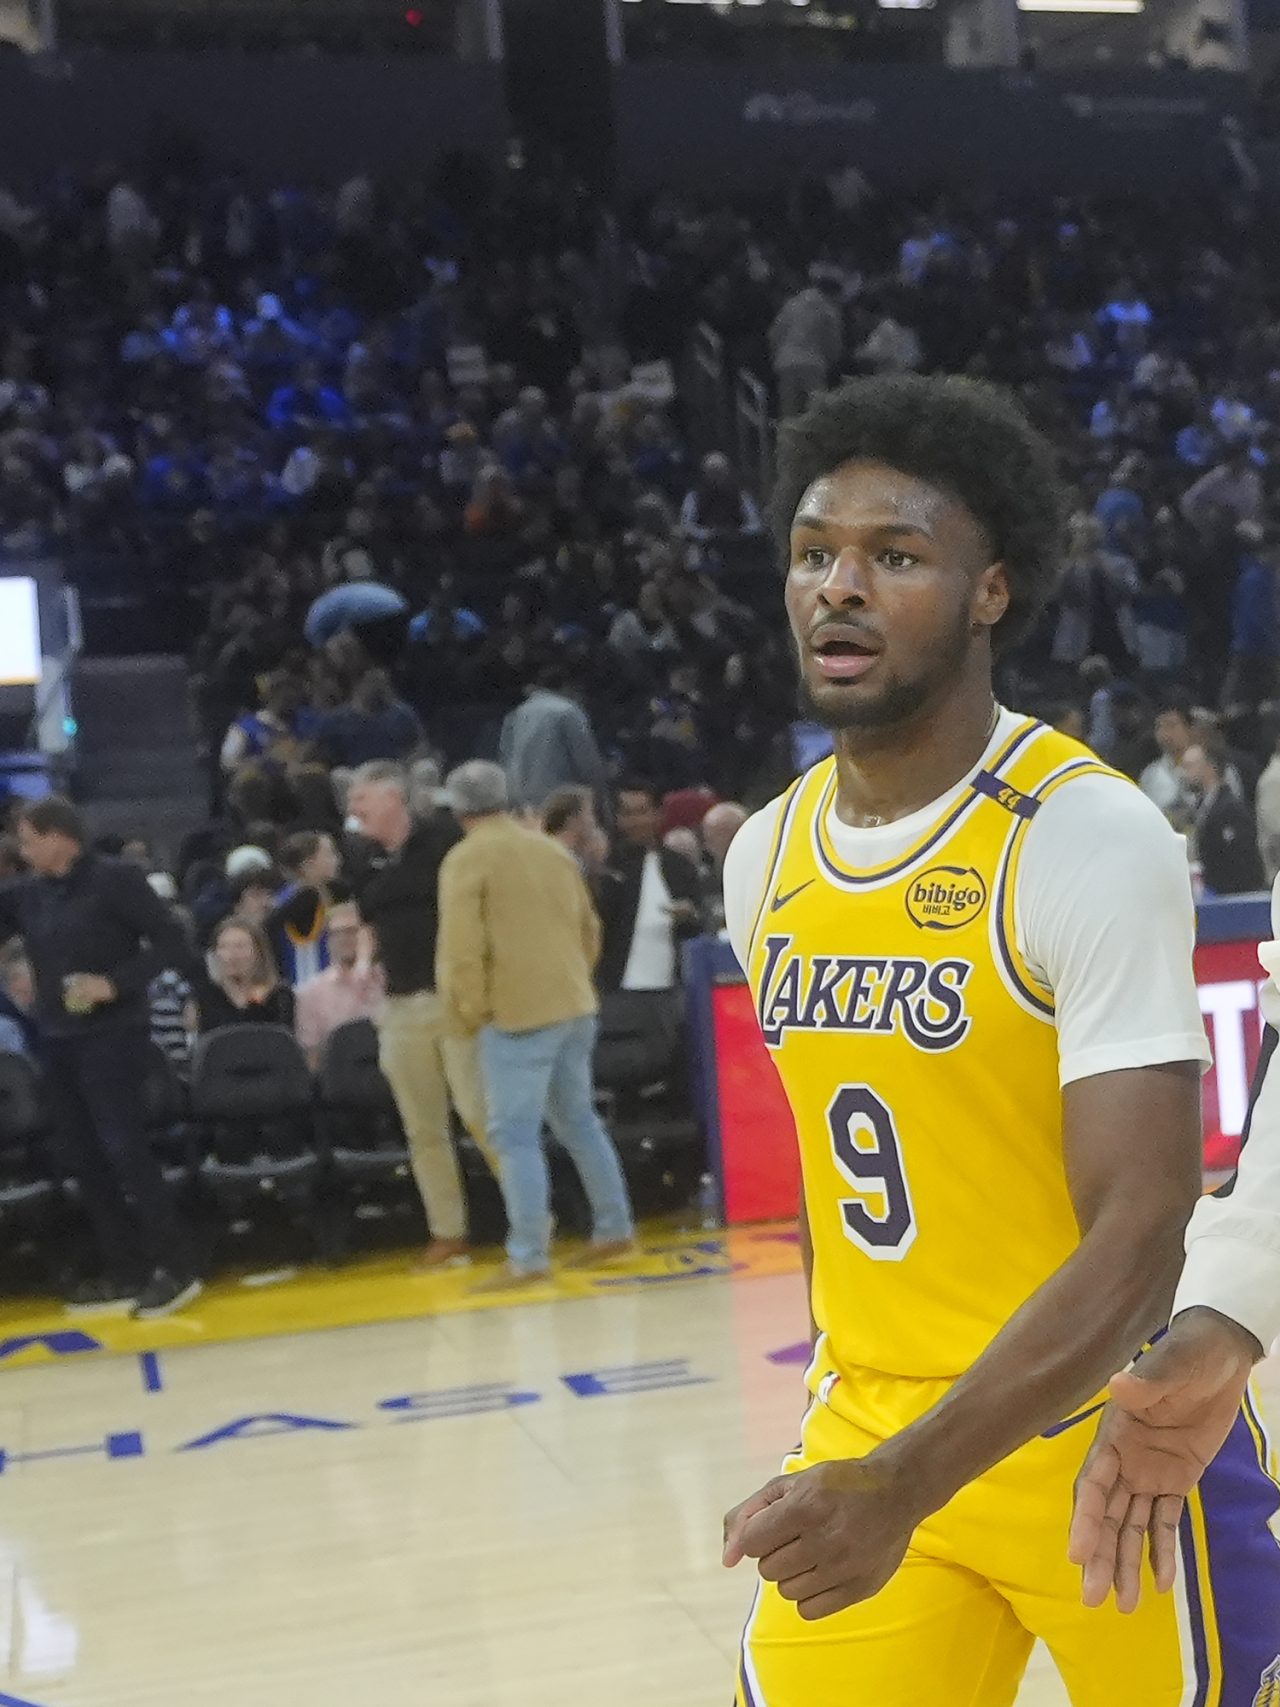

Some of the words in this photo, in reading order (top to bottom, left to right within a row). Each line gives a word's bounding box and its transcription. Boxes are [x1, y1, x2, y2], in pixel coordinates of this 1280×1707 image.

[997, 786, 1021, 810] 44
[913, 882, 981, 911] bibigo
[758, 934, 975, 1054] LAKERS
[825, 1083, 917, 1261] 9
